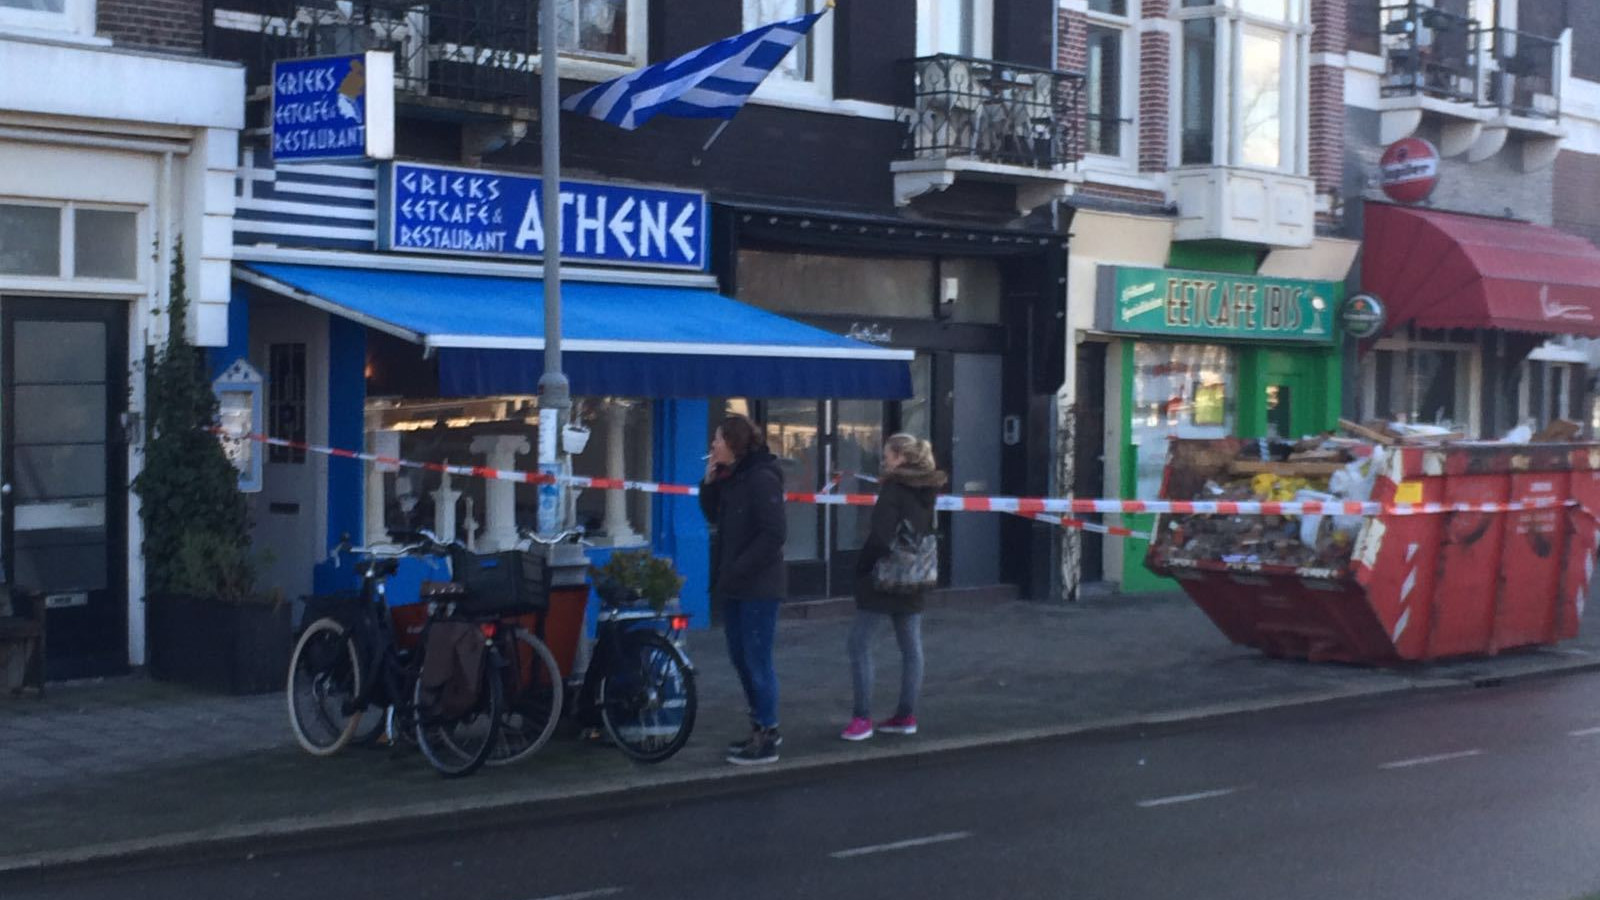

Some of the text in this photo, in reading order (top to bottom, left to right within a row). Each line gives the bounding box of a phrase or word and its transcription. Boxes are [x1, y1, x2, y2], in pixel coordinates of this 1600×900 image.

[277, 67, 336, 95] GRIEKS
[273, 125, 366, 152] RESTAURANT
[401, 172, 500, 201] GRIEKS
[400, 224, 507, 252] RESTAURANT
[514, 188, 696, 263] ATHENE
[1166, 277, 1258, 330] EETCAFE
